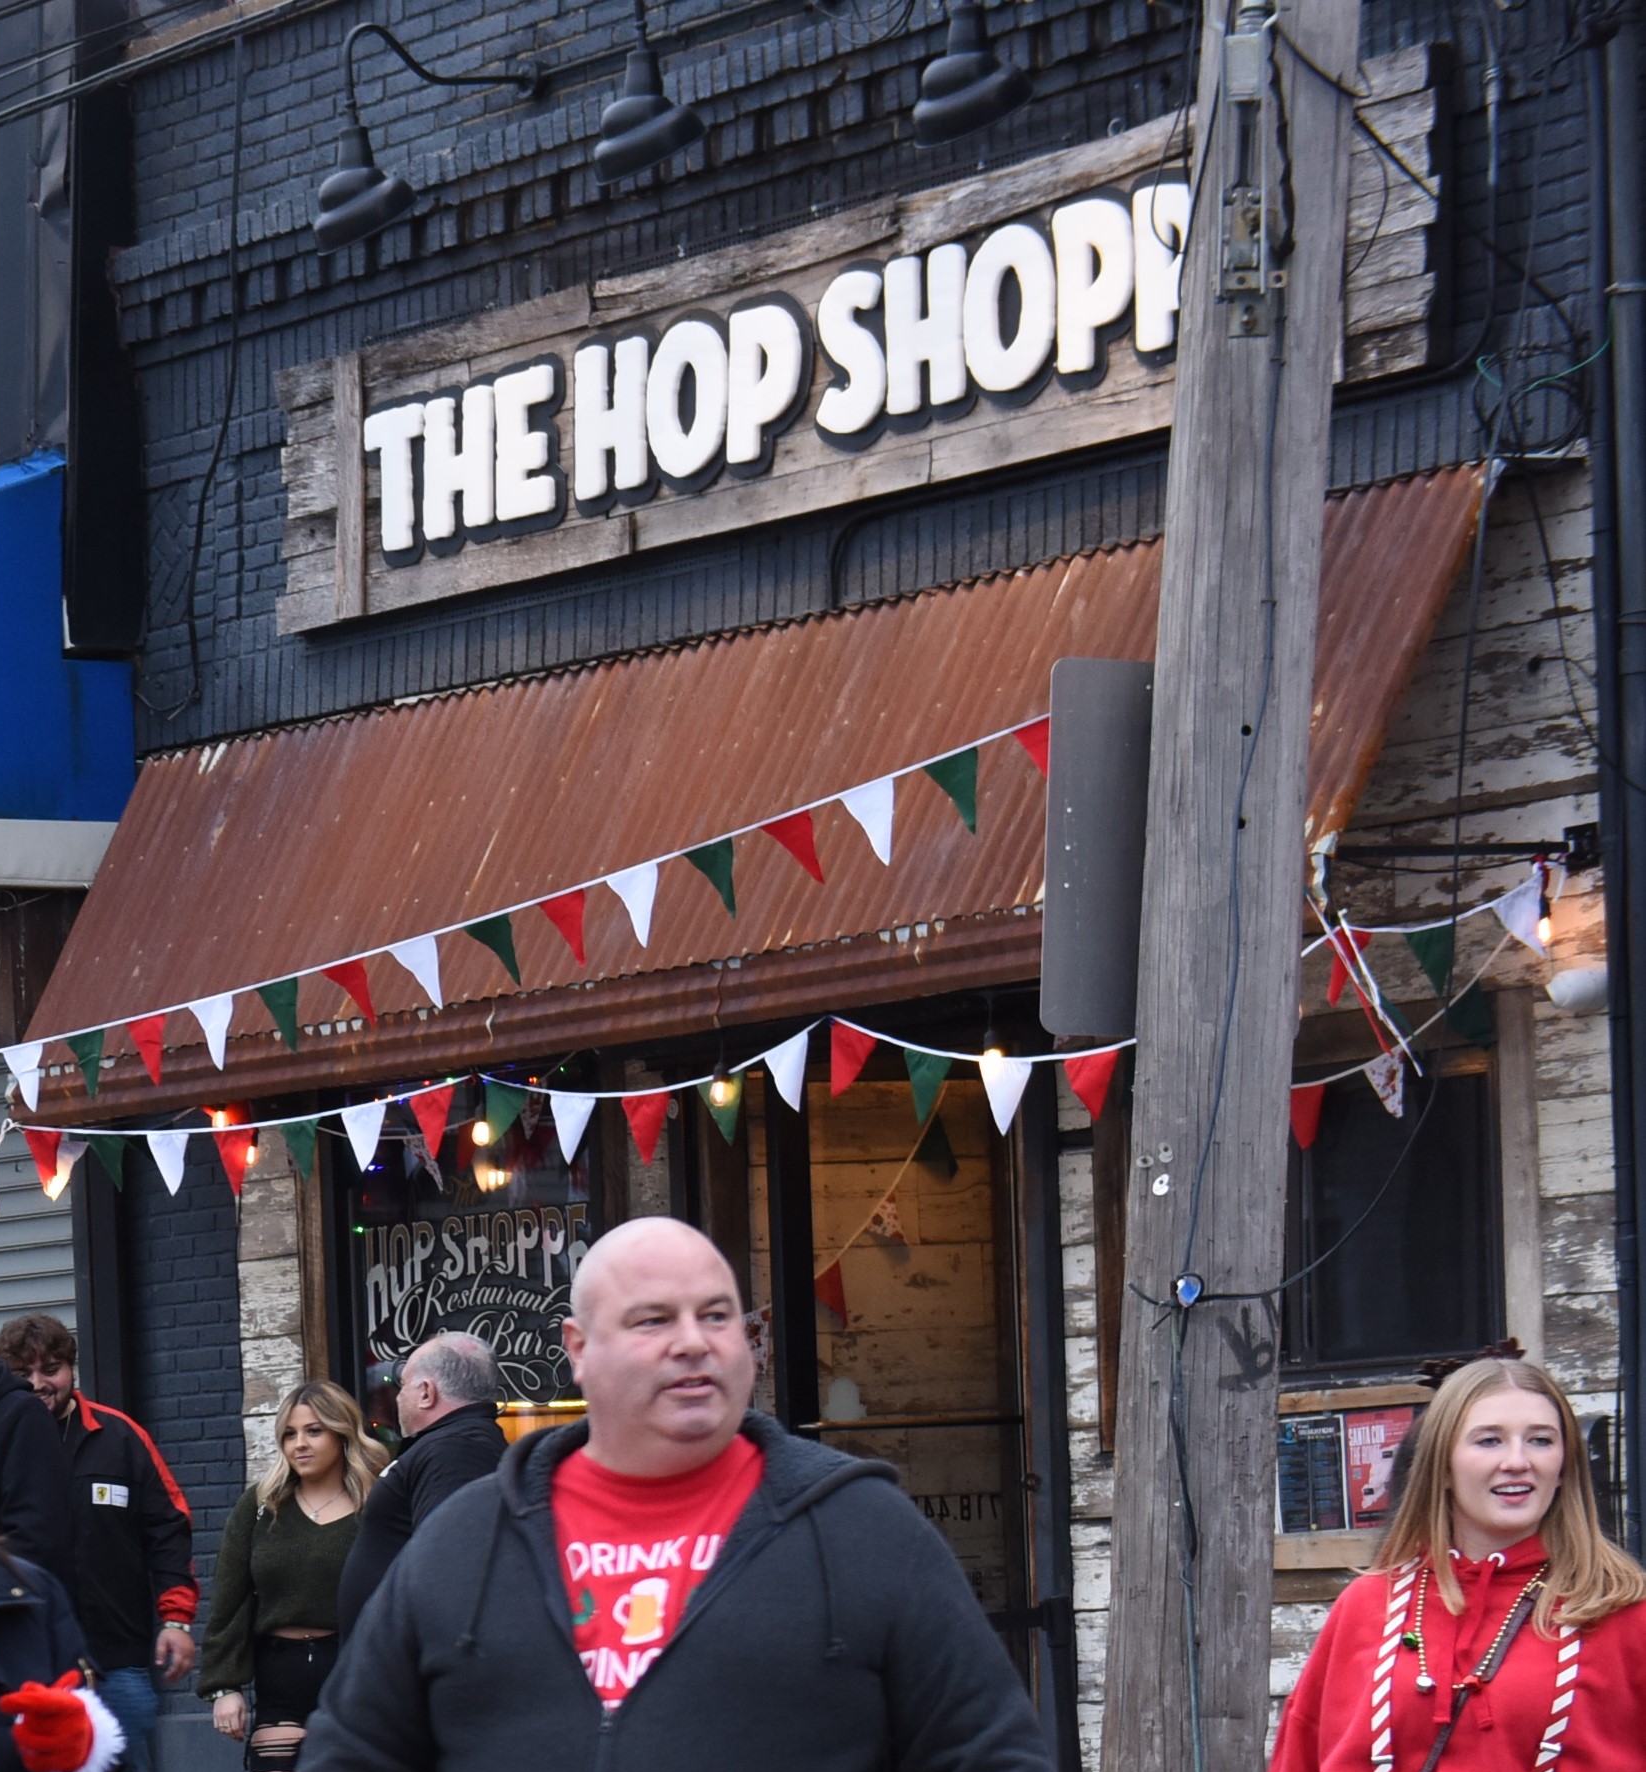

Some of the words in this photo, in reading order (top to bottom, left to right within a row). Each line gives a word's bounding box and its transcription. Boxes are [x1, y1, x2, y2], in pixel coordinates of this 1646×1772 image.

[363, 364, 556, 553] THE
[574, 304, 803, 502] HOP
[815, 183, 1192, 434] SHOPP
[365, 1220, 436, 1339] HOP
[564, 1535, 688, 1583] DRINK
[690, 1534, 724, 1571] U
